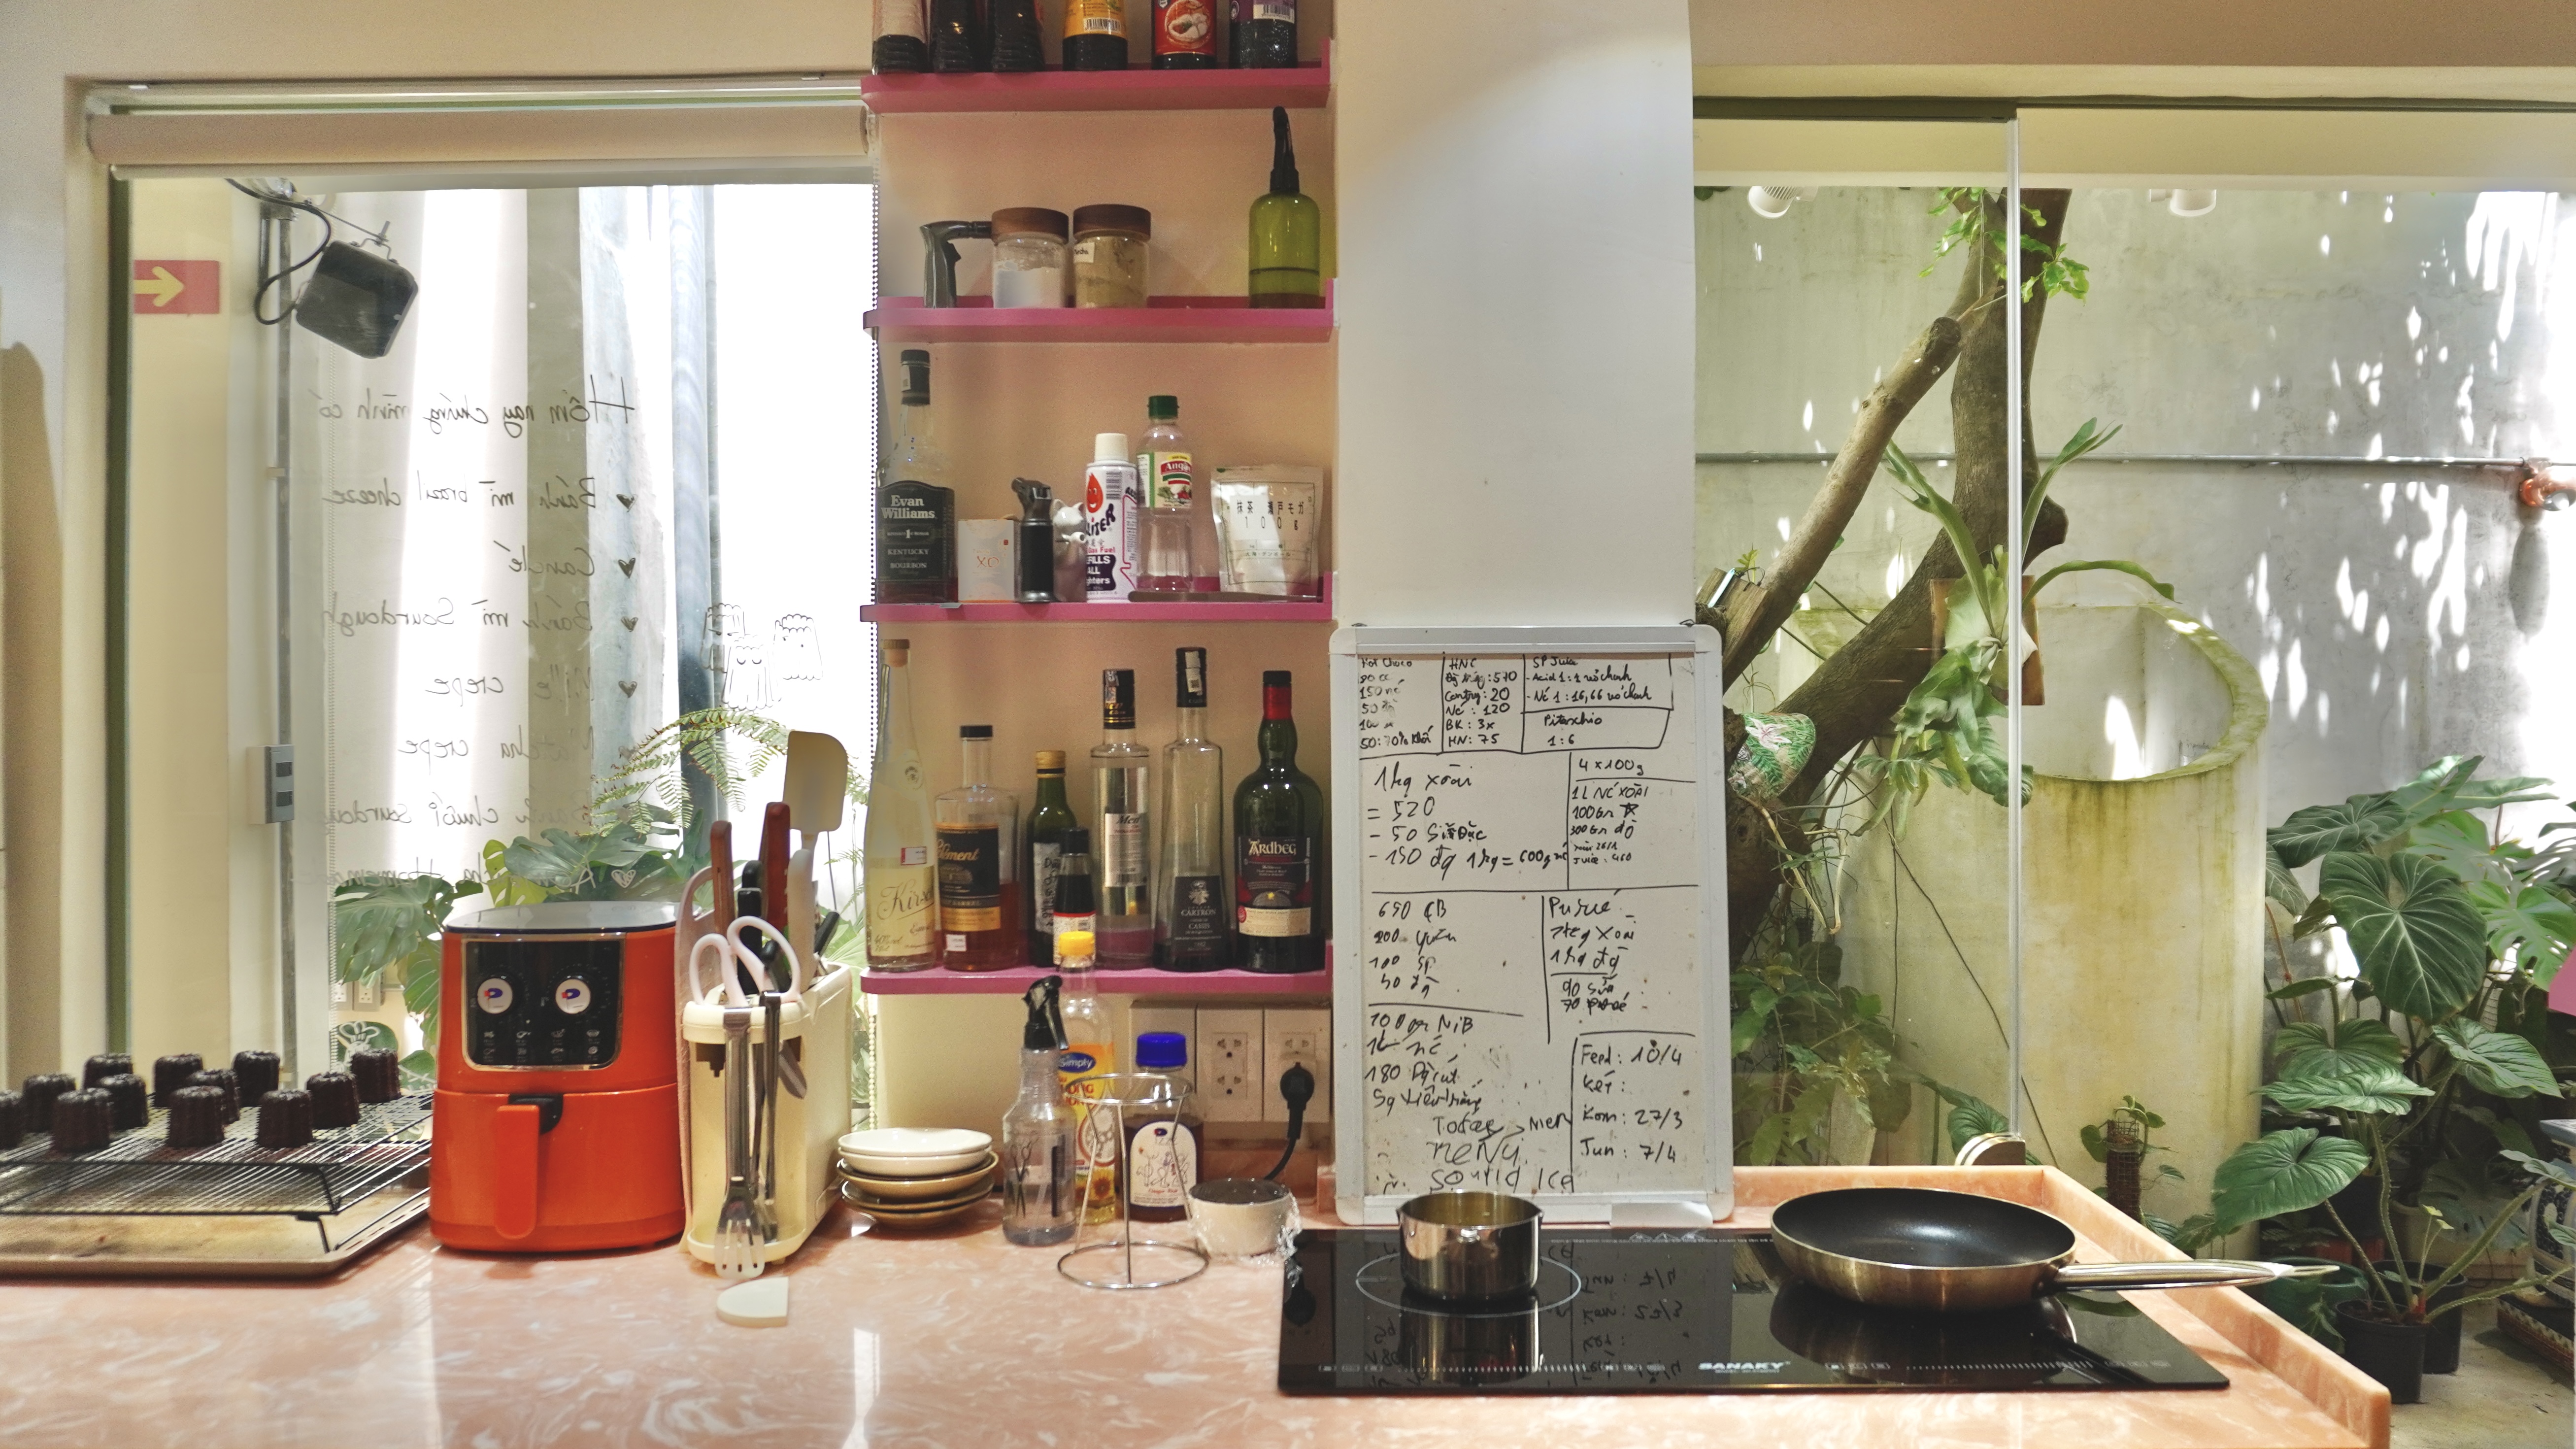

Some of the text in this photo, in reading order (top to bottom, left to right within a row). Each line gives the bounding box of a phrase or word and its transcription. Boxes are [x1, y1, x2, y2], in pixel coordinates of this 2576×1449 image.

[891, 495, 924, 506] Evan
[881, 507, 936, 519] Williams
[1490, 687, 1510, 702] 20
[1483, 703, 1510, 715] 120
[1478, 733, 1500, 744] 75
[1392, 796, 1435, 822] 520
[1060, 1057, 1093, 1069] Simply
[1635, 1108, 1683, 1130] 27/3
